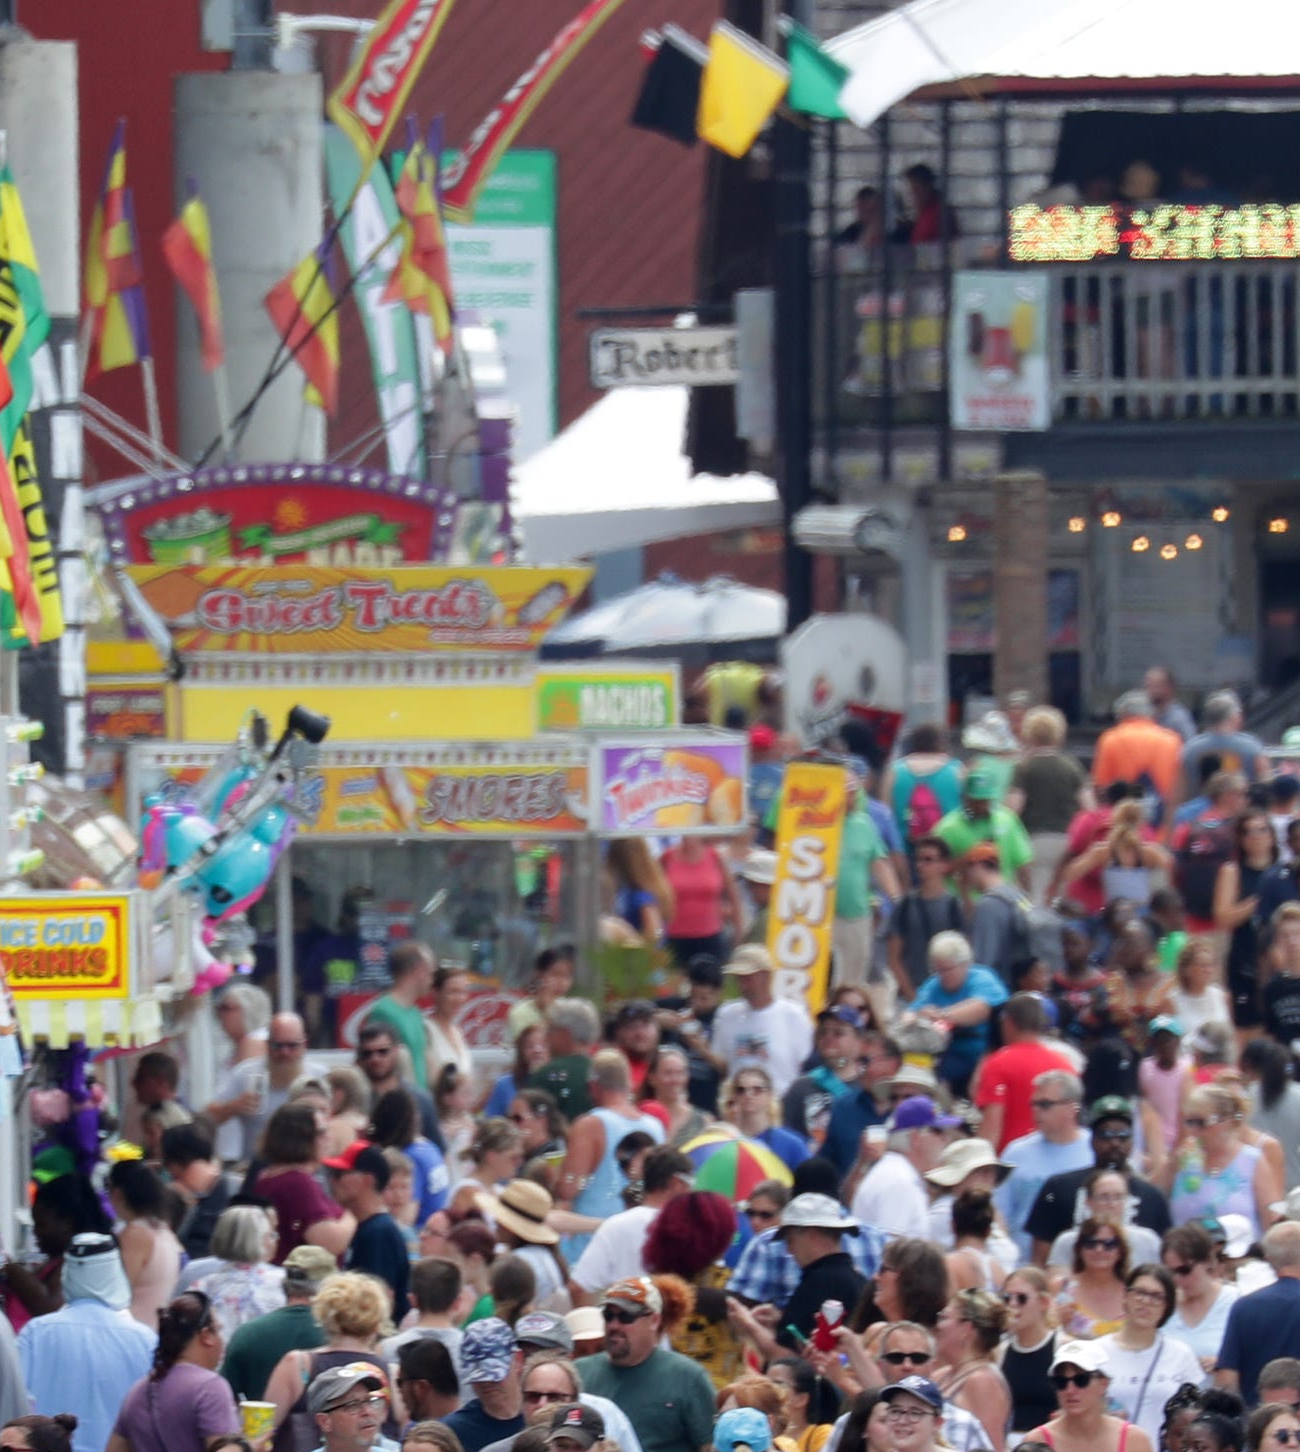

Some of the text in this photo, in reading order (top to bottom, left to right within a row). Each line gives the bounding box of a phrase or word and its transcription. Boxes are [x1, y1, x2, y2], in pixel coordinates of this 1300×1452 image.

[199, 578, 496, 634] Sweet Treats
[580, 684, 665, 727] NACHOS
[0, 917, 105, 948] ICE COLD
